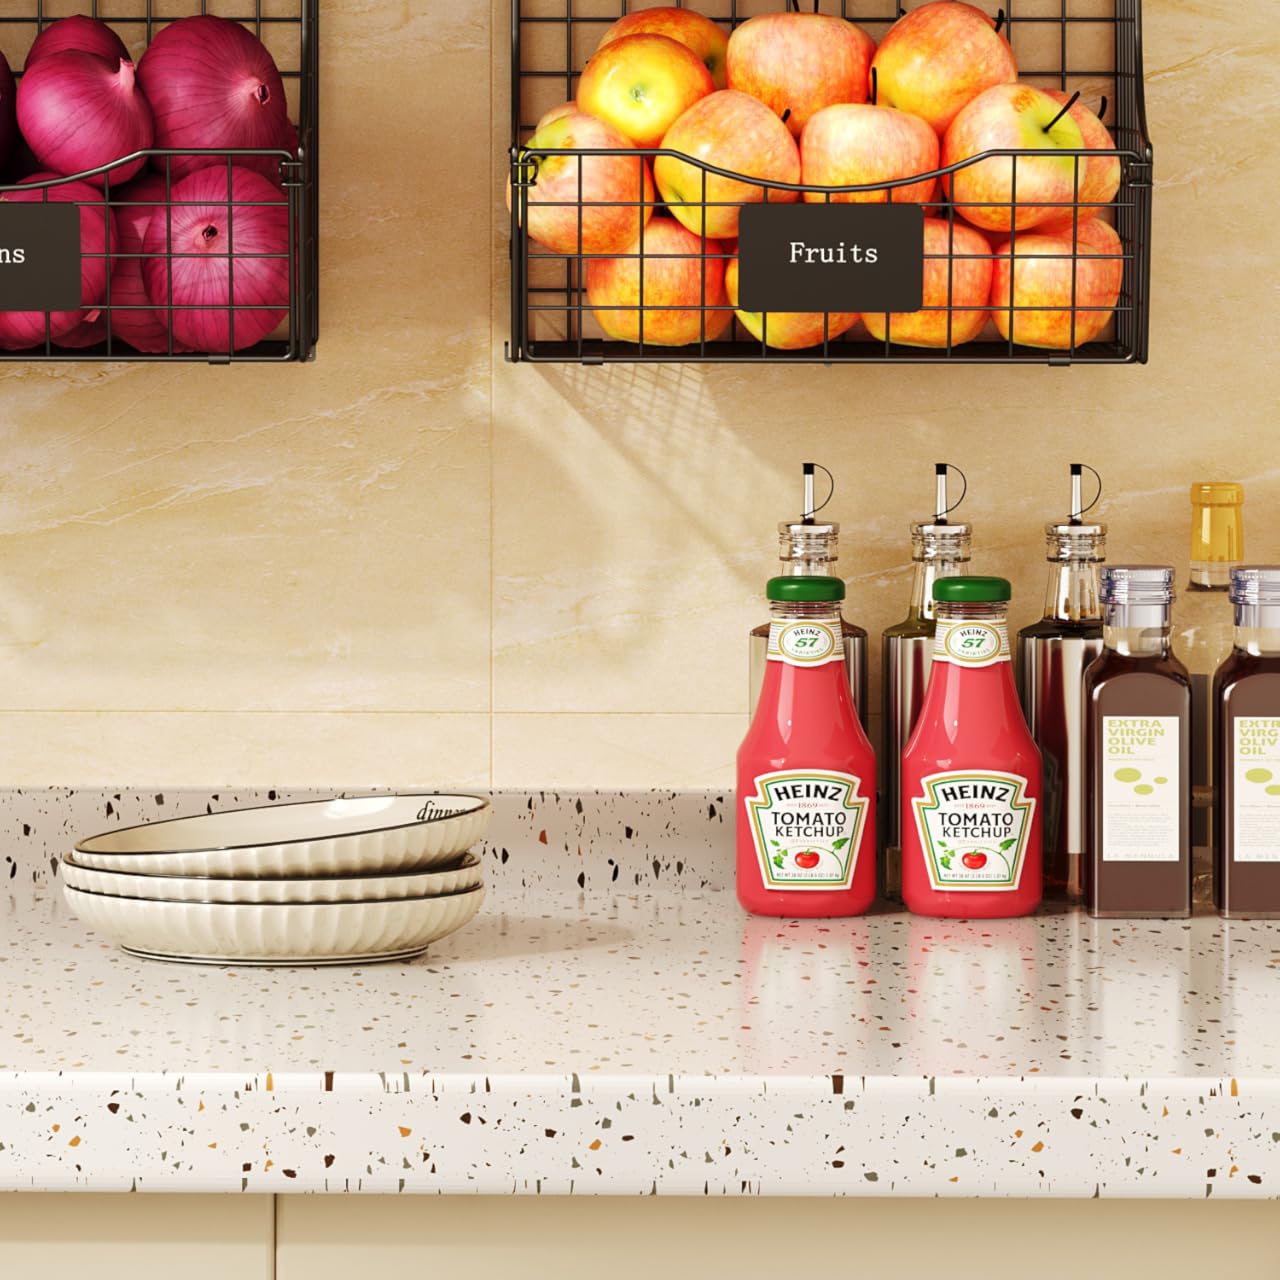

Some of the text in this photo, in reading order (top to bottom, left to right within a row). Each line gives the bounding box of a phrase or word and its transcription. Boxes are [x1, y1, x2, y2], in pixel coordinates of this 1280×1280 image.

[789, 241, 878, 264] Fruits
[793, 628, 822, 637] HEINZ
[960, 629, 988, 637] HEINZ
[795, 637, 819, 648] 57
[961, 638, 986, 648] 57
[1108, 719, 1162, 728] EXTRA
[1108, 728, 1165, 736] VIRGIN
[1108, 737, 1157, 746] OLIVE
[1108, 746, 1136, 755] OIL
[1239, 746, 1267, 755] OIL
[774, 784, 842, 802] HEINZ
[942, 785, 1010, 802] HEINZ
[771, 811, 847, 826] TOMATO
[938, 812, 1014, 826] TOMATO
[775, 826, 844, 838] KETCHUP
[942, 826, 1012, 838] KETCHUP
